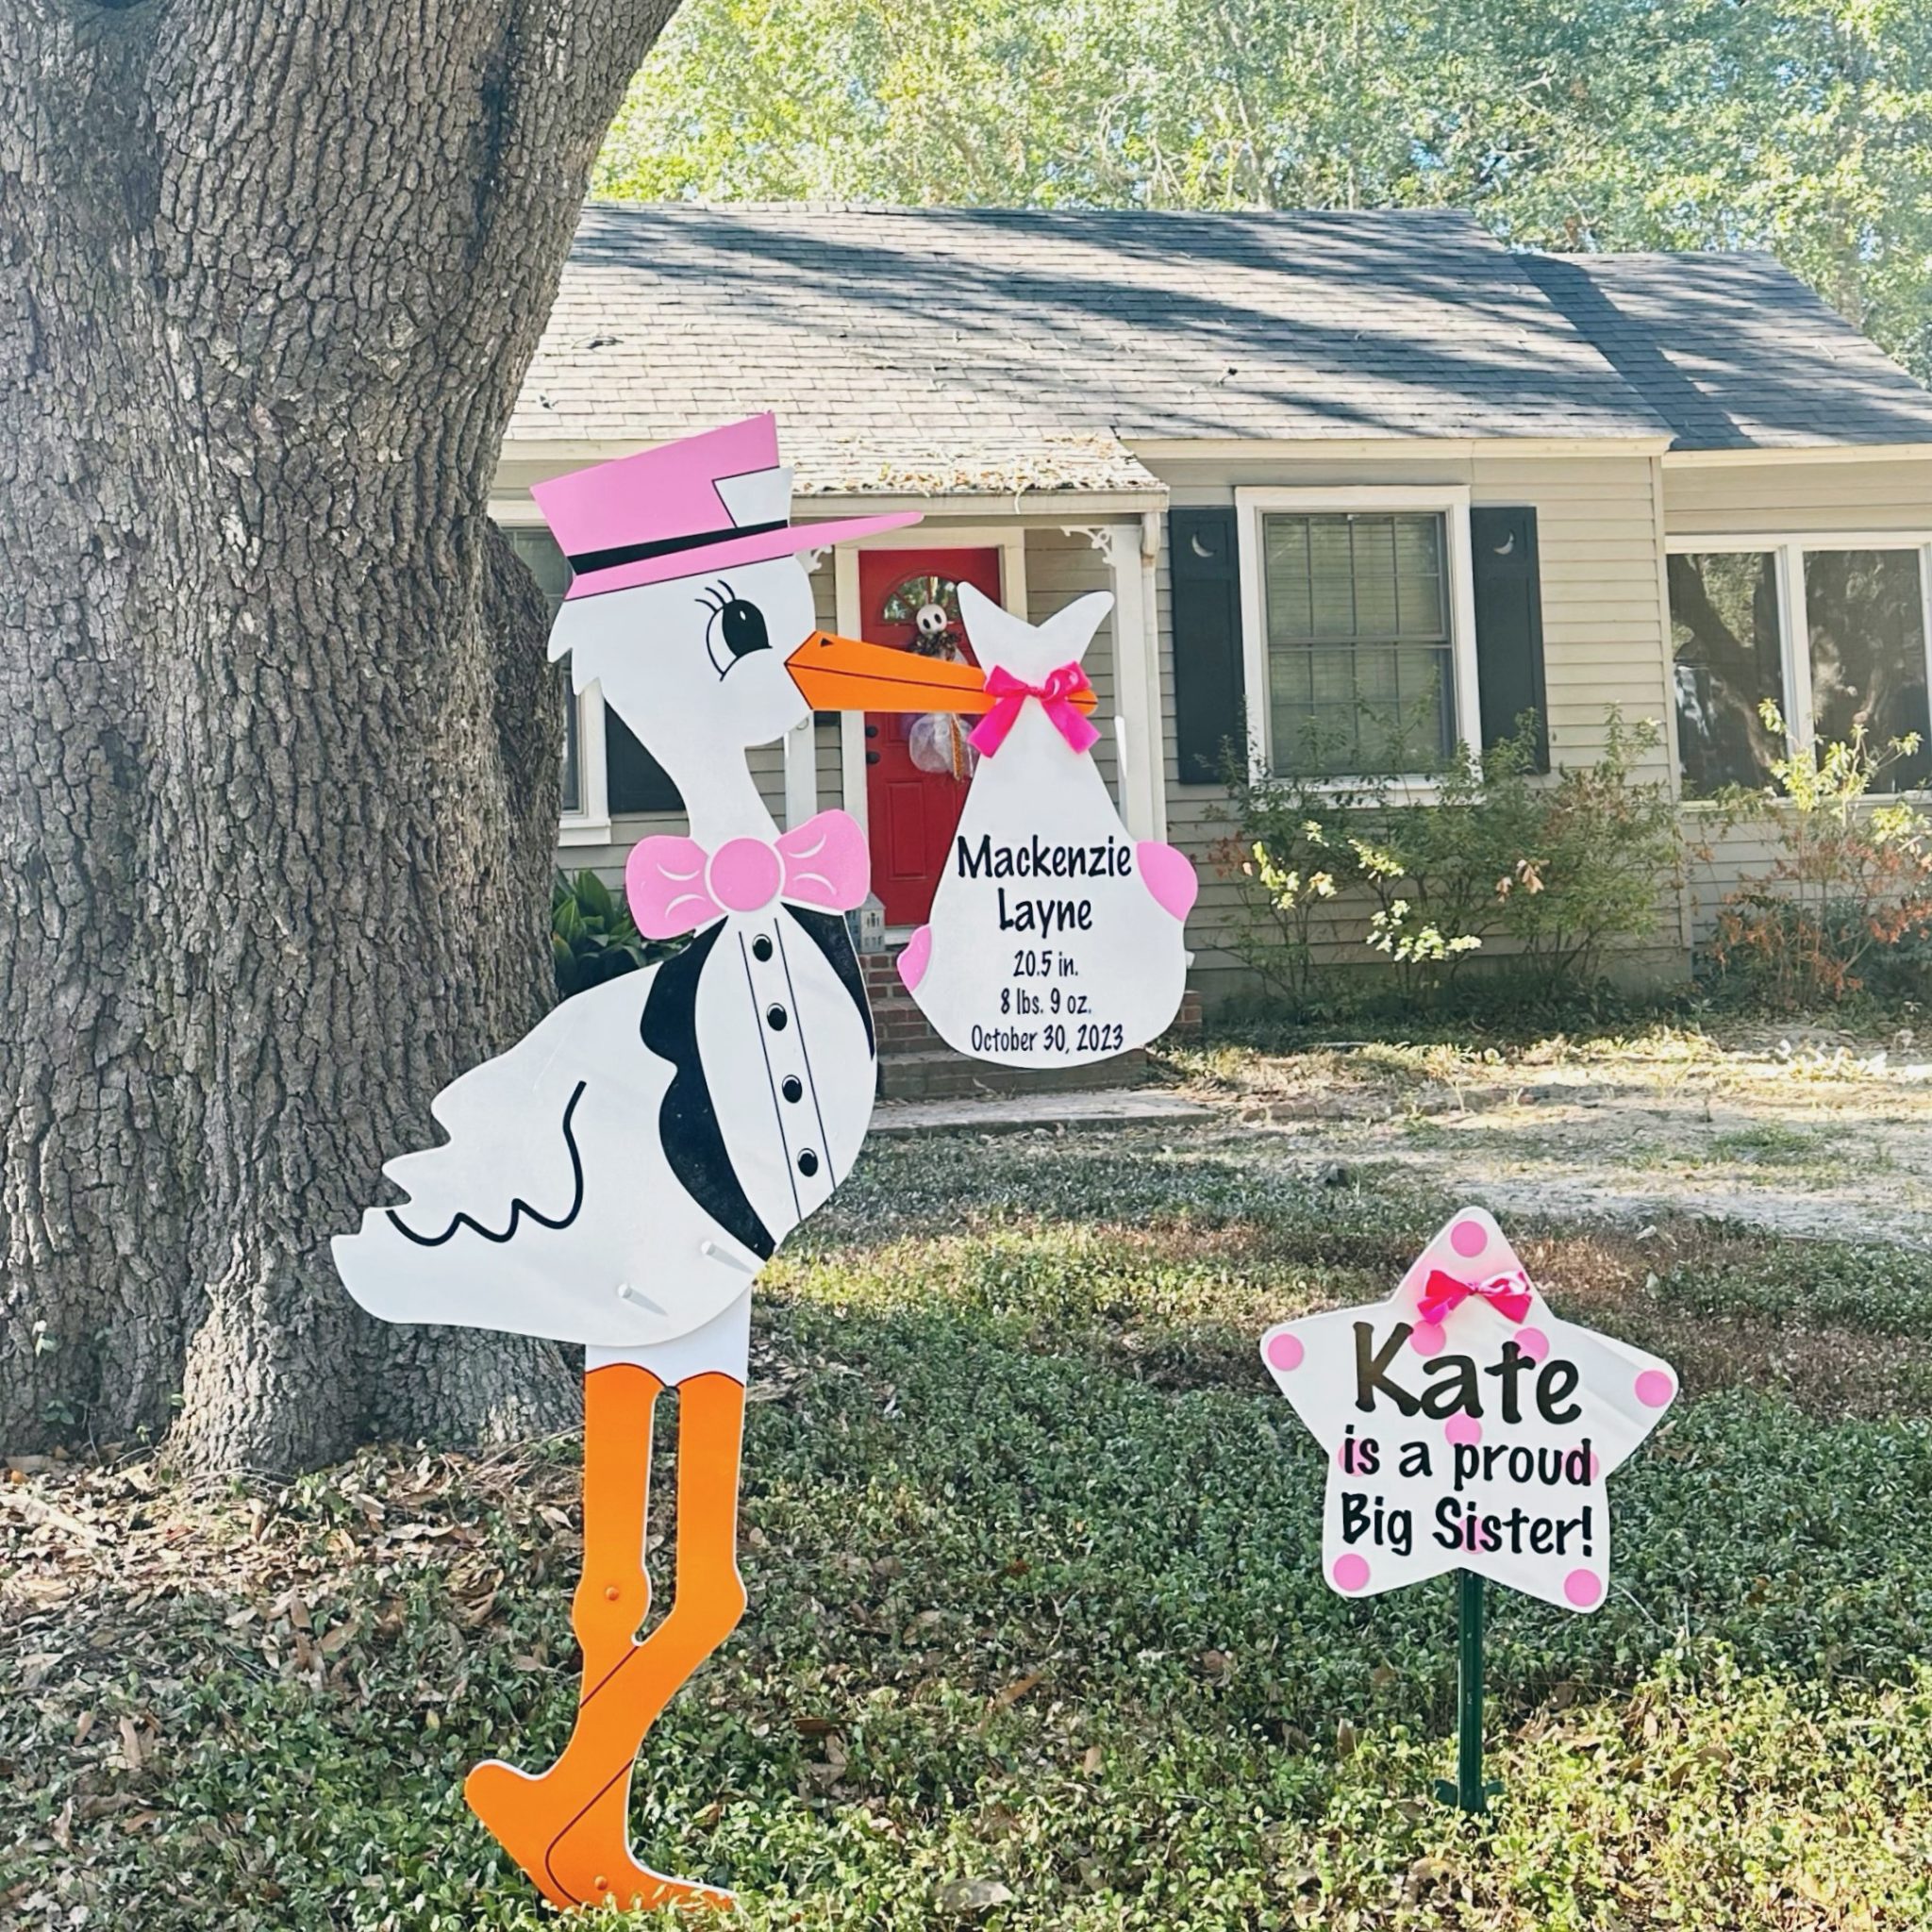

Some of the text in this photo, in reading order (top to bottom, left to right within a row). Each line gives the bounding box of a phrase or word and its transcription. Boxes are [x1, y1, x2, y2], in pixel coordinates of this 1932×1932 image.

[958, 834, 1132, 878] Mackenzie
[997, 888, 1092, 939] Layne
[1012, 950, 1079, 977] 20.5 in.
[1000, 988, 1091, 1014] 8 lbs. 9 oz.
[971, 1024, 1124, 1054] October 30, 2023
[1353, 1322, 1582, 1424] Kate
[1343, 1424, 1591, 1491] is a proud
[1341, 1492, 1593, 1557] Big Sister!
